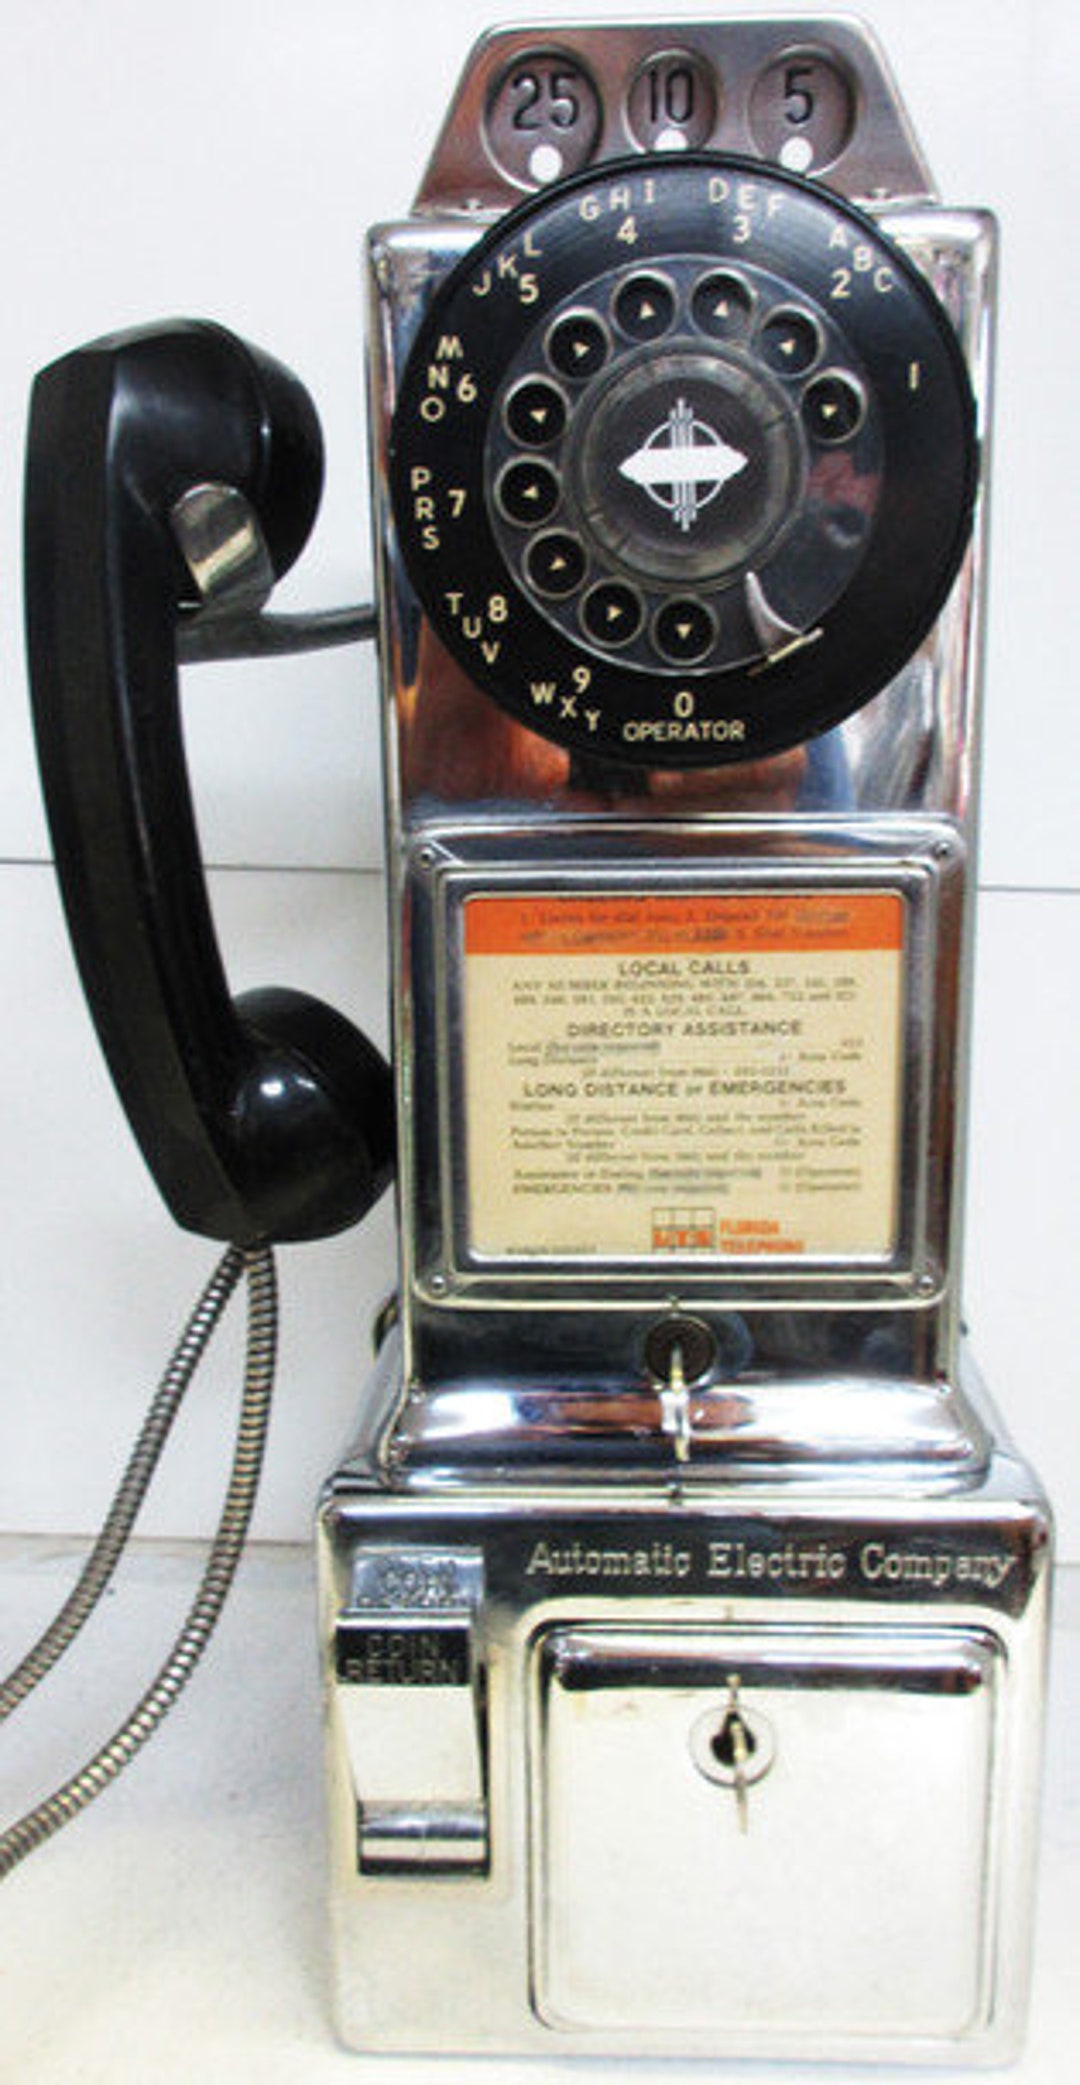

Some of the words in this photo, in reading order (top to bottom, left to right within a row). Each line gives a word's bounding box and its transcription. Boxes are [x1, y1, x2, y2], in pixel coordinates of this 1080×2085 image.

[513, 71, 580, 132] 25
[647, 67, 694, 124] 10
[784, 67, 813, 125] 5
[616, 217, 638, 244] 4
[731, 215, 753, 244] 3
[519, 274, 540, 305] 5
[830, 269, 852, 297] 2
[456, 374, 478, 403] 6
[448, 488, 468, 518] 7
[487, 595, 509, 623] 8
[572, 667, 592, 694] 9
[622, 720, 746, 742] OPERATOR
[617, 960, 681, 976] LOCAL
[688, 960, 750, 975] CALLS
[566, 1021, 674, 1037] DIRECTORY
[682, 1020, 802, 1036] ASSISTANCE
[523, 1083, 578, 1098] LONG
[584, 1082, 678, 1097] DISTANCE
[709, 1079, 847, 1095] EMERGENCIES
[720, 1219, 780, 1235] FLORIDA
[525, 1542, 691, 1577] Automatic
[706, 1542, 846, 1578] Electric
[860, 1543, 1017, 1588] Company
[366, 1633, 440, 1659] COIN
[343, 1658, 461, 1683] RETURN
